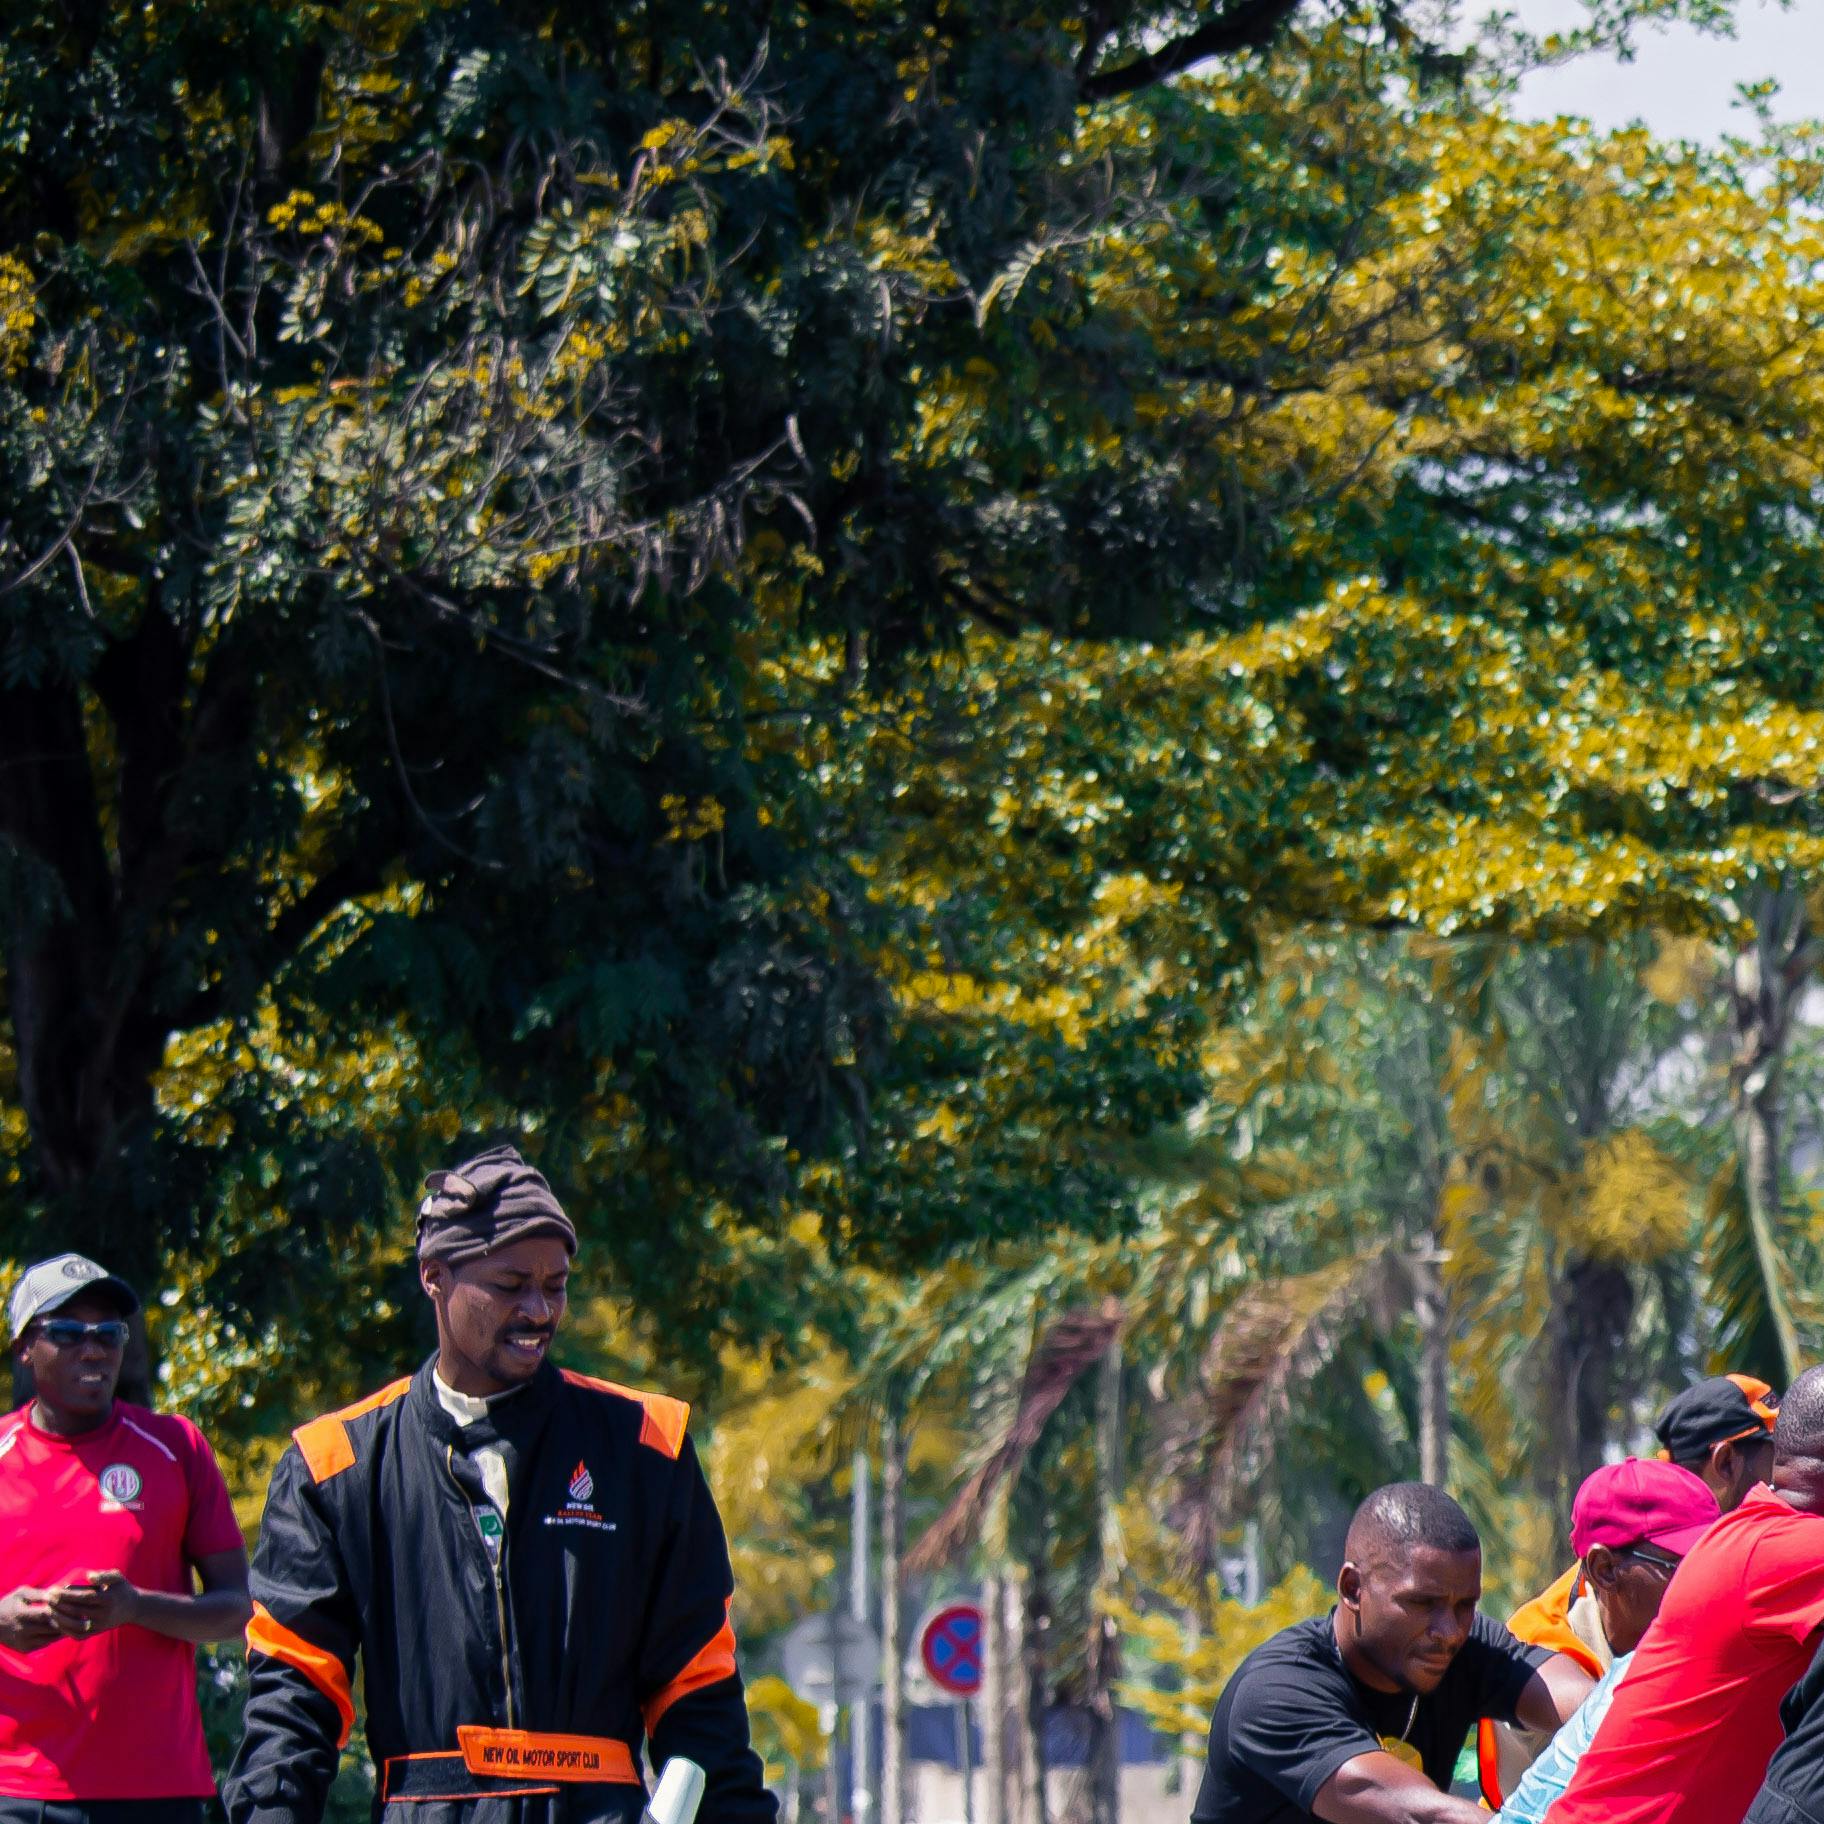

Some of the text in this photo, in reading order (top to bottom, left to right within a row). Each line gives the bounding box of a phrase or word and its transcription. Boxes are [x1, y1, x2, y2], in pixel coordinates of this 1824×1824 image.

[483, 1746, 600, 1769] NEW OIL MOTOR SPORT CLUB
